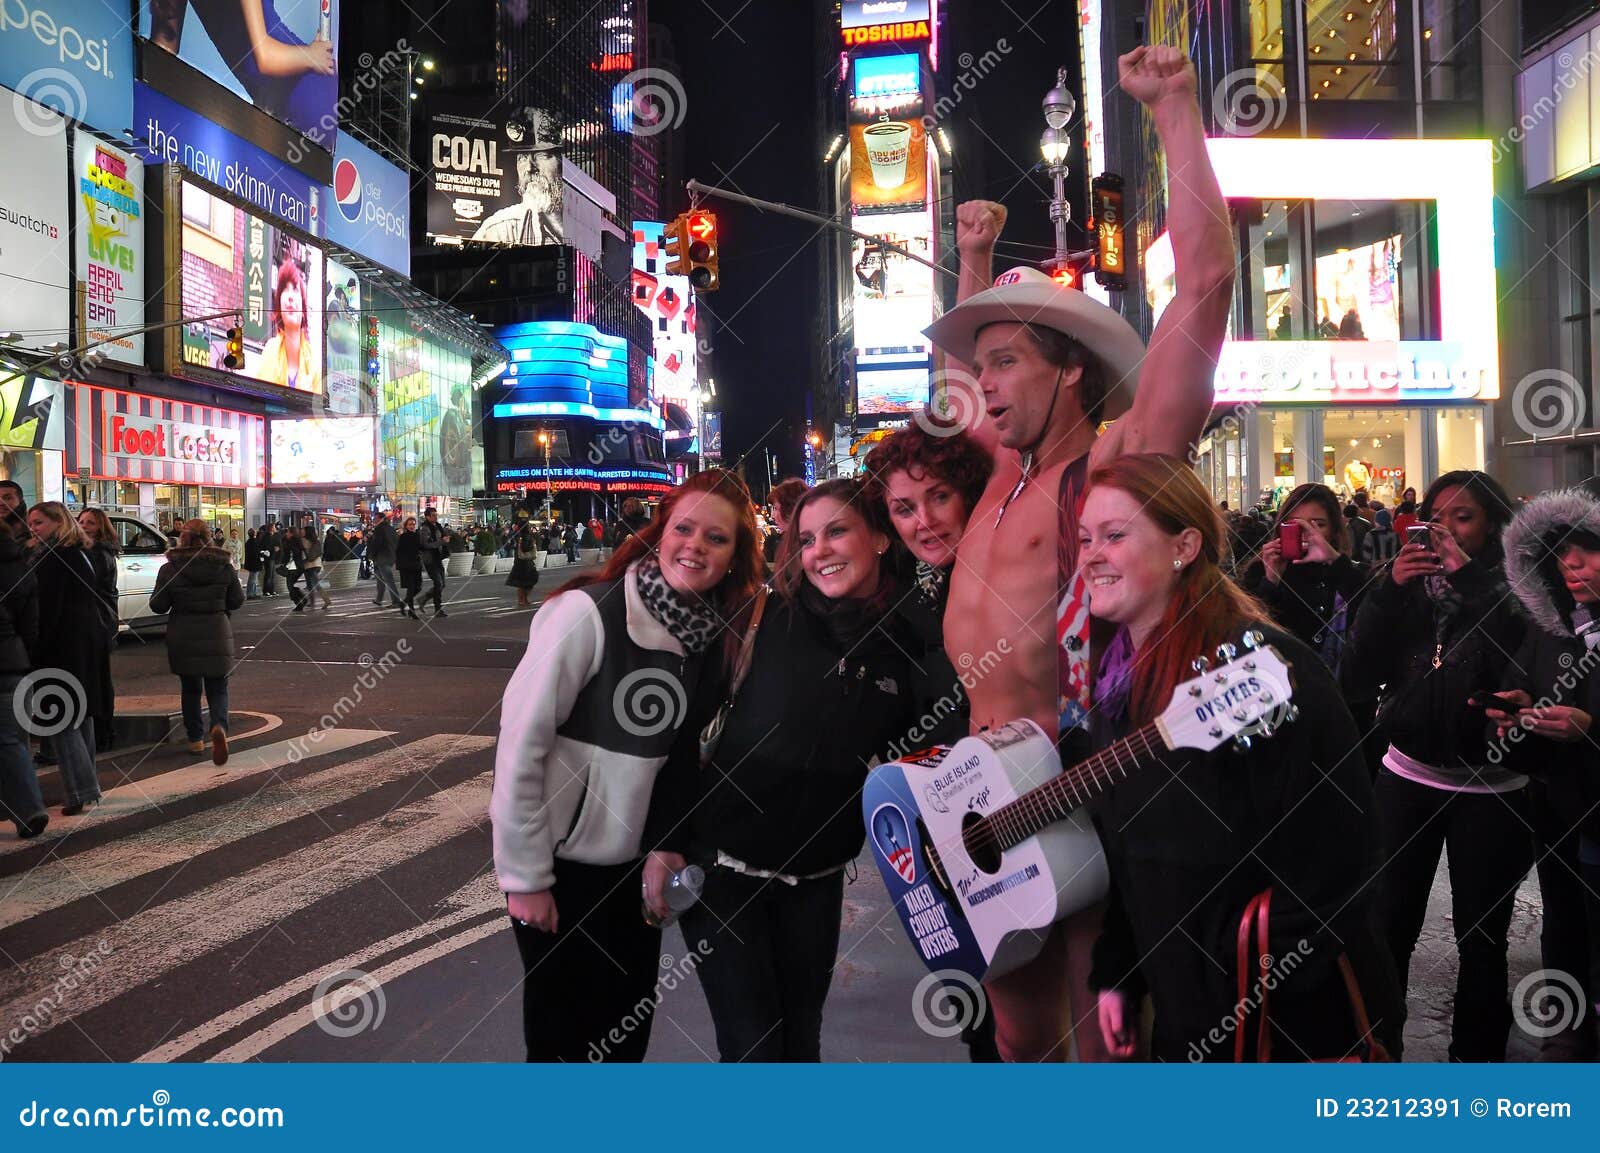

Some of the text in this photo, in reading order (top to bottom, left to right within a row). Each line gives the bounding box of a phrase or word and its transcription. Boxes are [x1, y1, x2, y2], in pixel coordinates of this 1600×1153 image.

[841, 21, 930, 45] TOSHIBA
[432, 133, 504, 176] COAL
[147, 118, 179, 163] the
[184, 143, 221, 185] new
[225, 161, 275, 215] skinny
[279, 192, 305, 225] can
[435, 172, 482, 187] WEDNESDAYS
[0, 207, 50, 236] swatch
[366, 201, 405, 239] pepsi
[88, 233, 135, 273] LIVE!
[88, 263, 124, 291] APRIL
[557, 246, 566, 293] 1500
[88, 282, 115, 305] 2ND
[88, 302, 116, 326] 8PM
[110, 415, 166, 457] Foot
[878, 420, 910, 428] SONY
[497, 482, 514, 491] LOVE
[542, 468, 562, 476] DATE
[597, 470, 630, 478] ARRESTED
[607, 483, 627, 491] LAIRD
[1195, 677, 1260, 723] OYSTERS
[934, 772, 955, 792] BLUE
[953, 755, 980, 778] ISLAND
[903, 883, 936, 916] NAKED
[909, 902, 949, 939] COWBOY
[919, 926, 960, 960] OYSTERS
